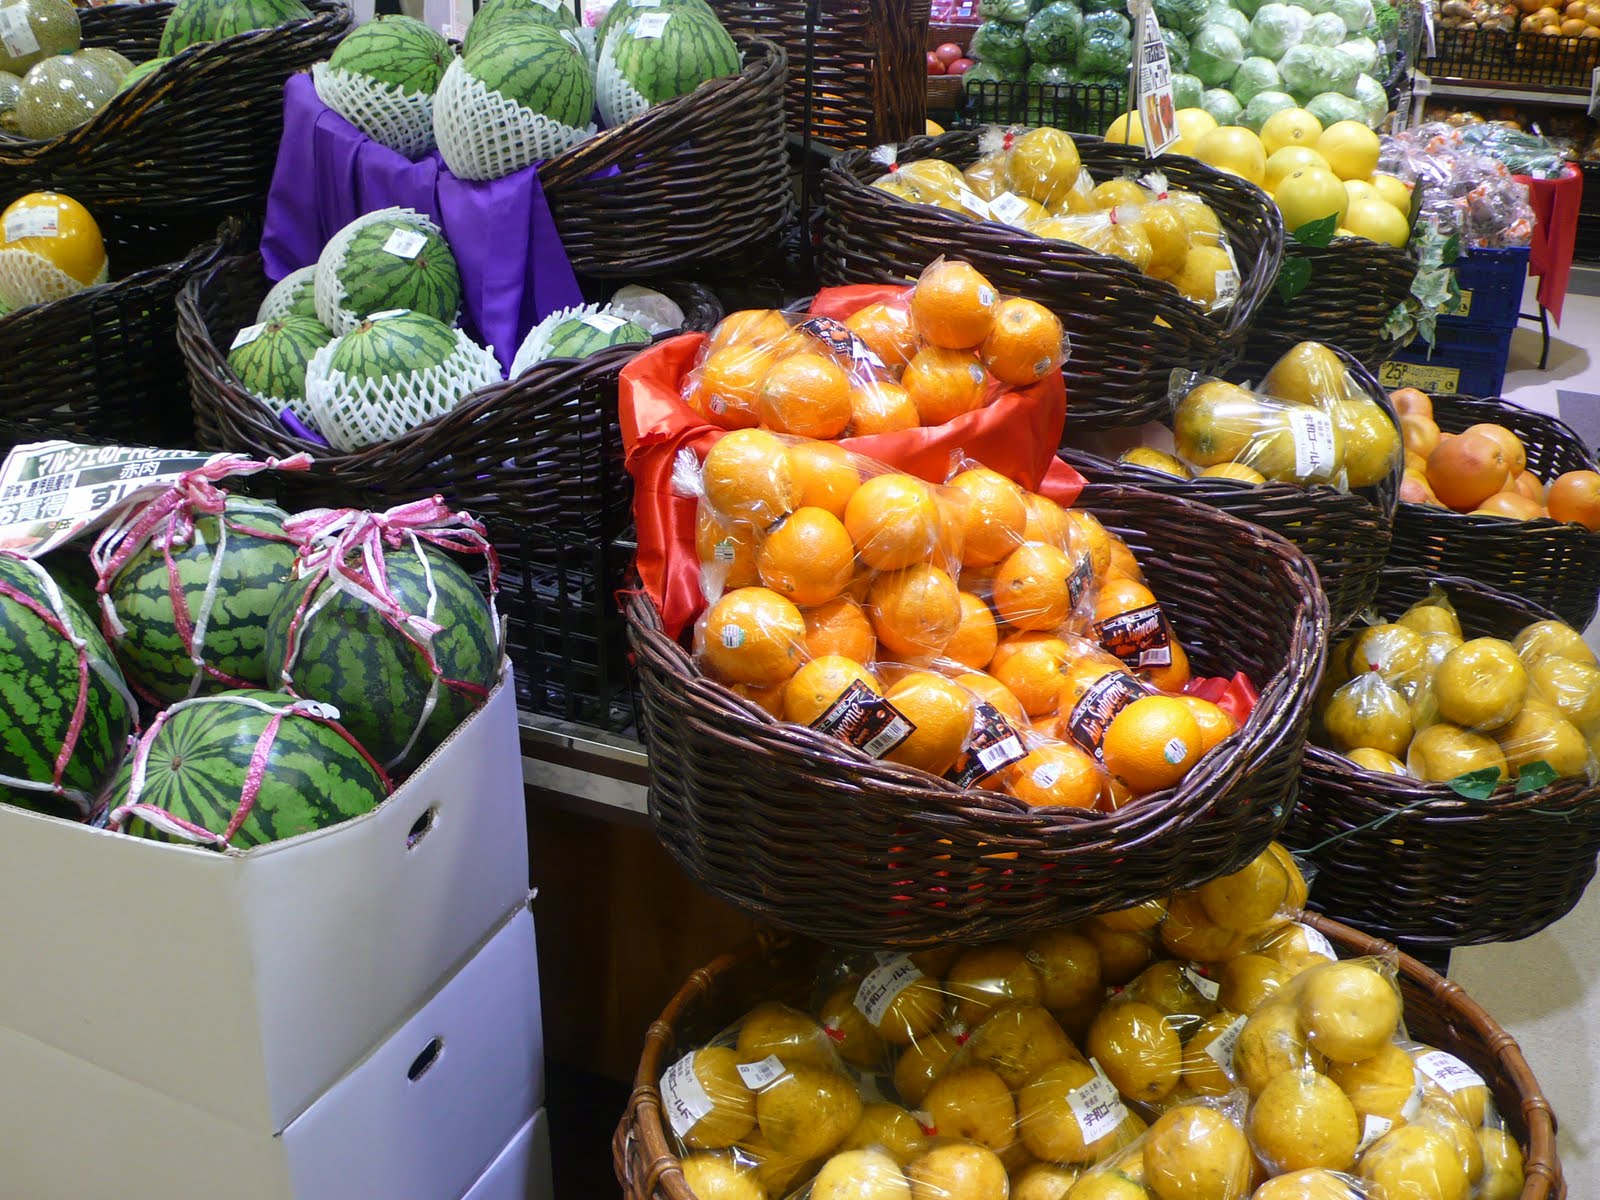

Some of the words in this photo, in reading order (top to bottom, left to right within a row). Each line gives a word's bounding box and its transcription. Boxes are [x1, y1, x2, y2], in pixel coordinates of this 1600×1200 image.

[119, 461, 161, 480] 赤肉
[0, 494, 67, 525] お買得
